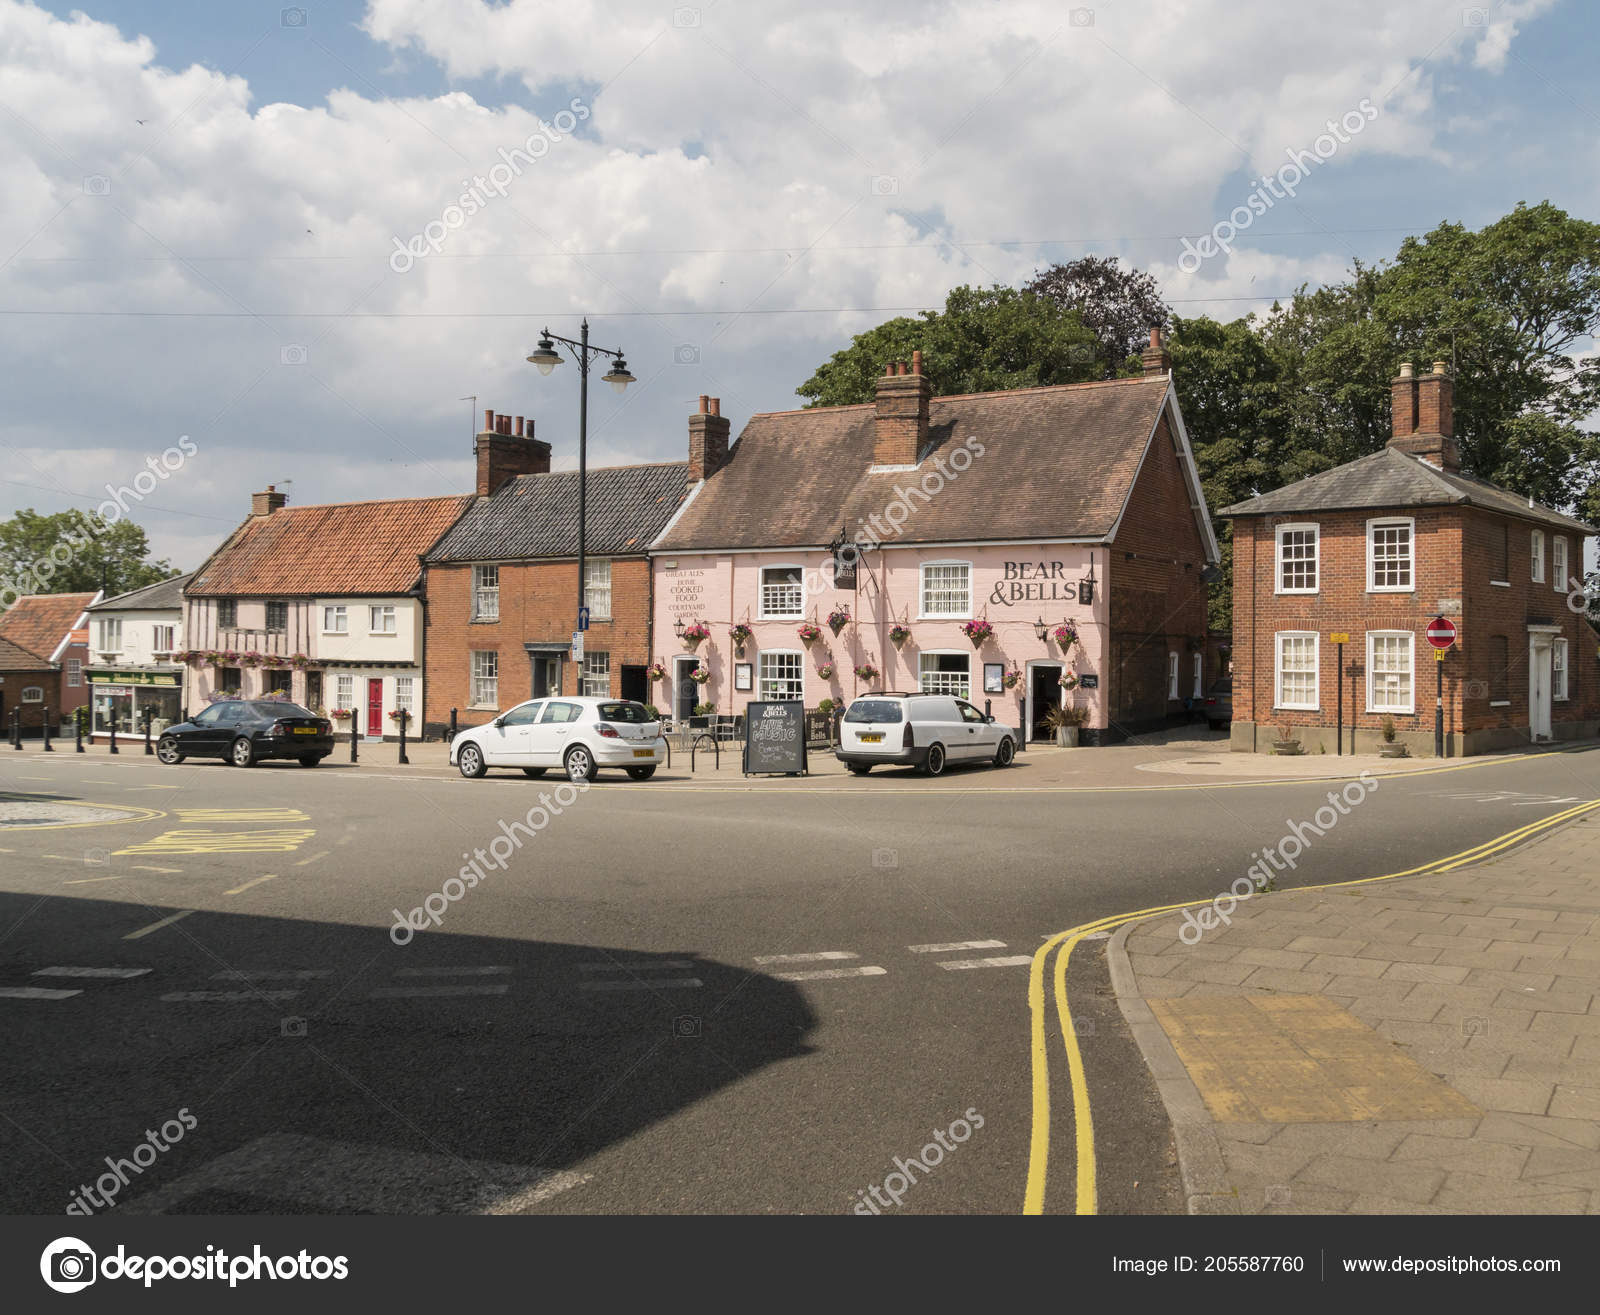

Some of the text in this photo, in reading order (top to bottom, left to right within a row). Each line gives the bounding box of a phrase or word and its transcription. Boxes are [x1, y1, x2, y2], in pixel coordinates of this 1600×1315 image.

[1004, 561, 1066, 580] BEAR
[670, 586, 704, 594] COOKED
[990, 581, 1077, 607] &BELLS
[675, 594, 698, 602] FOOD
[760, 719, 784, 730] LIVE
[753, 728, 796, 742] MUSIC
[810, 729, 827, 741] Bells
